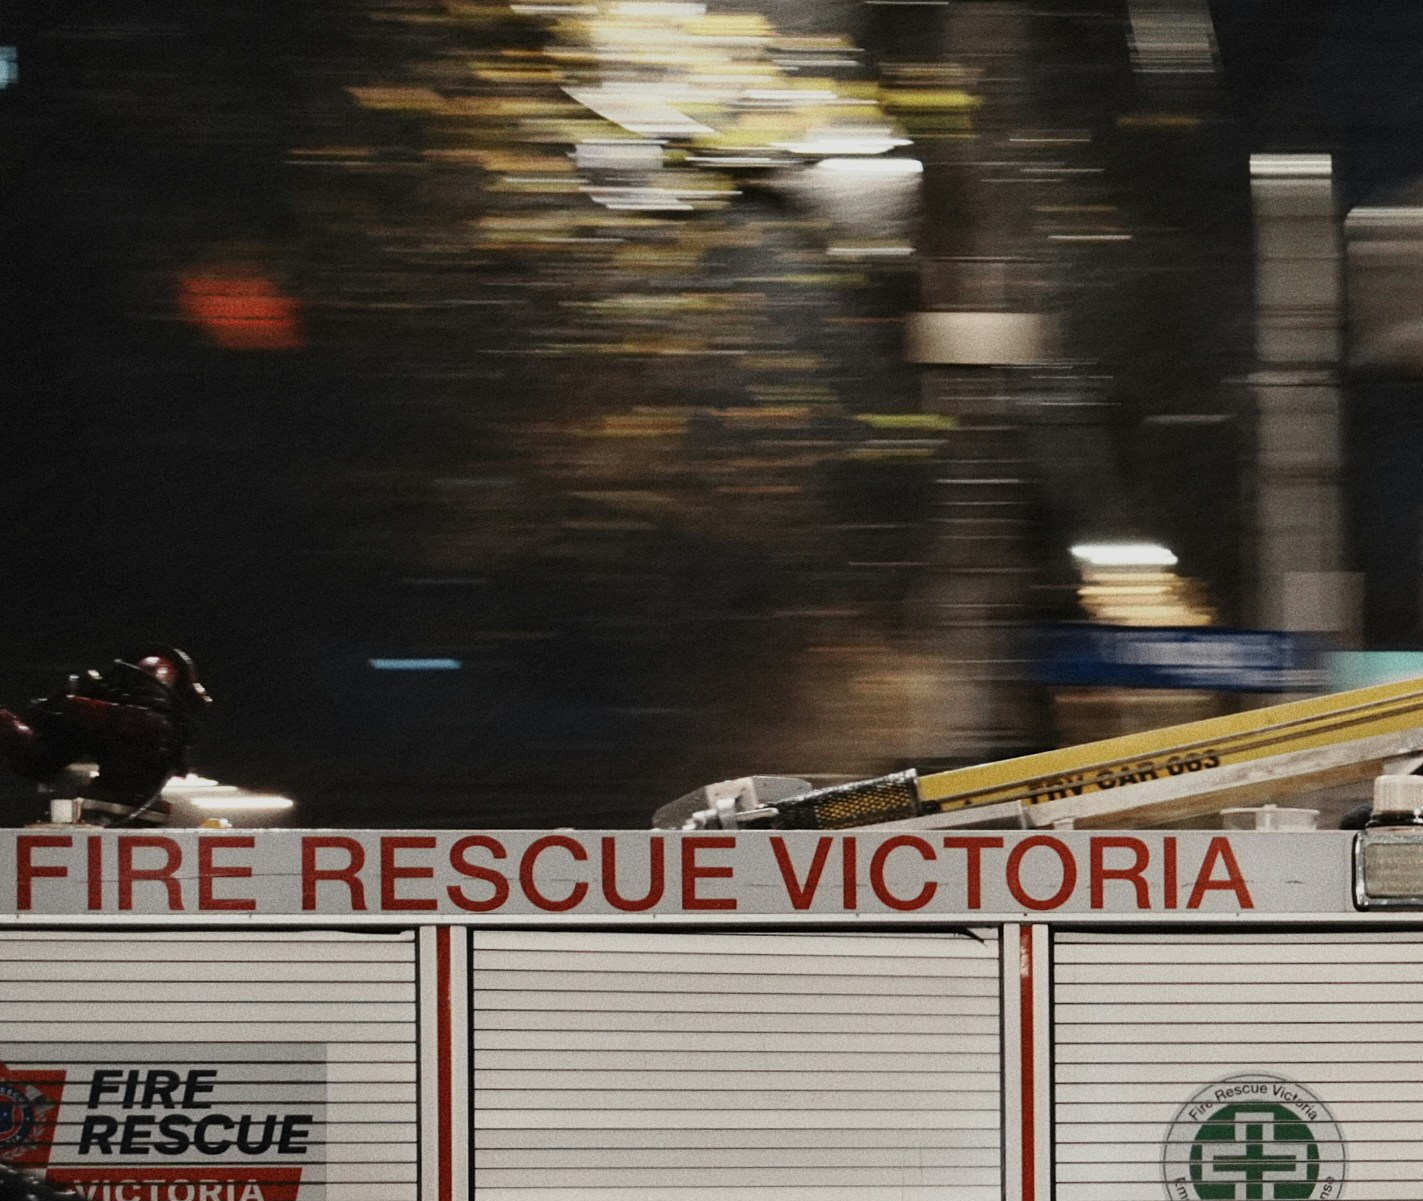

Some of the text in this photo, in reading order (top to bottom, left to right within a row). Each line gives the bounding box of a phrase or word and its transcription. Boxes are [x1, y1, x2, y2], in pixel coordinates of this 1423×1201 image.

[1096, 760, 1159, 790] CAR
[1166, 749, 1221, 776] 063
[15, 834, 1255, 913] FIRE RESCUE VICTORIA
[87, 1069, 218, 1110] FIRE
[1188, 1083, 1319, 1121] Fire Rescue Victoria
[77, 1113, 314, 1156] RESCUE
